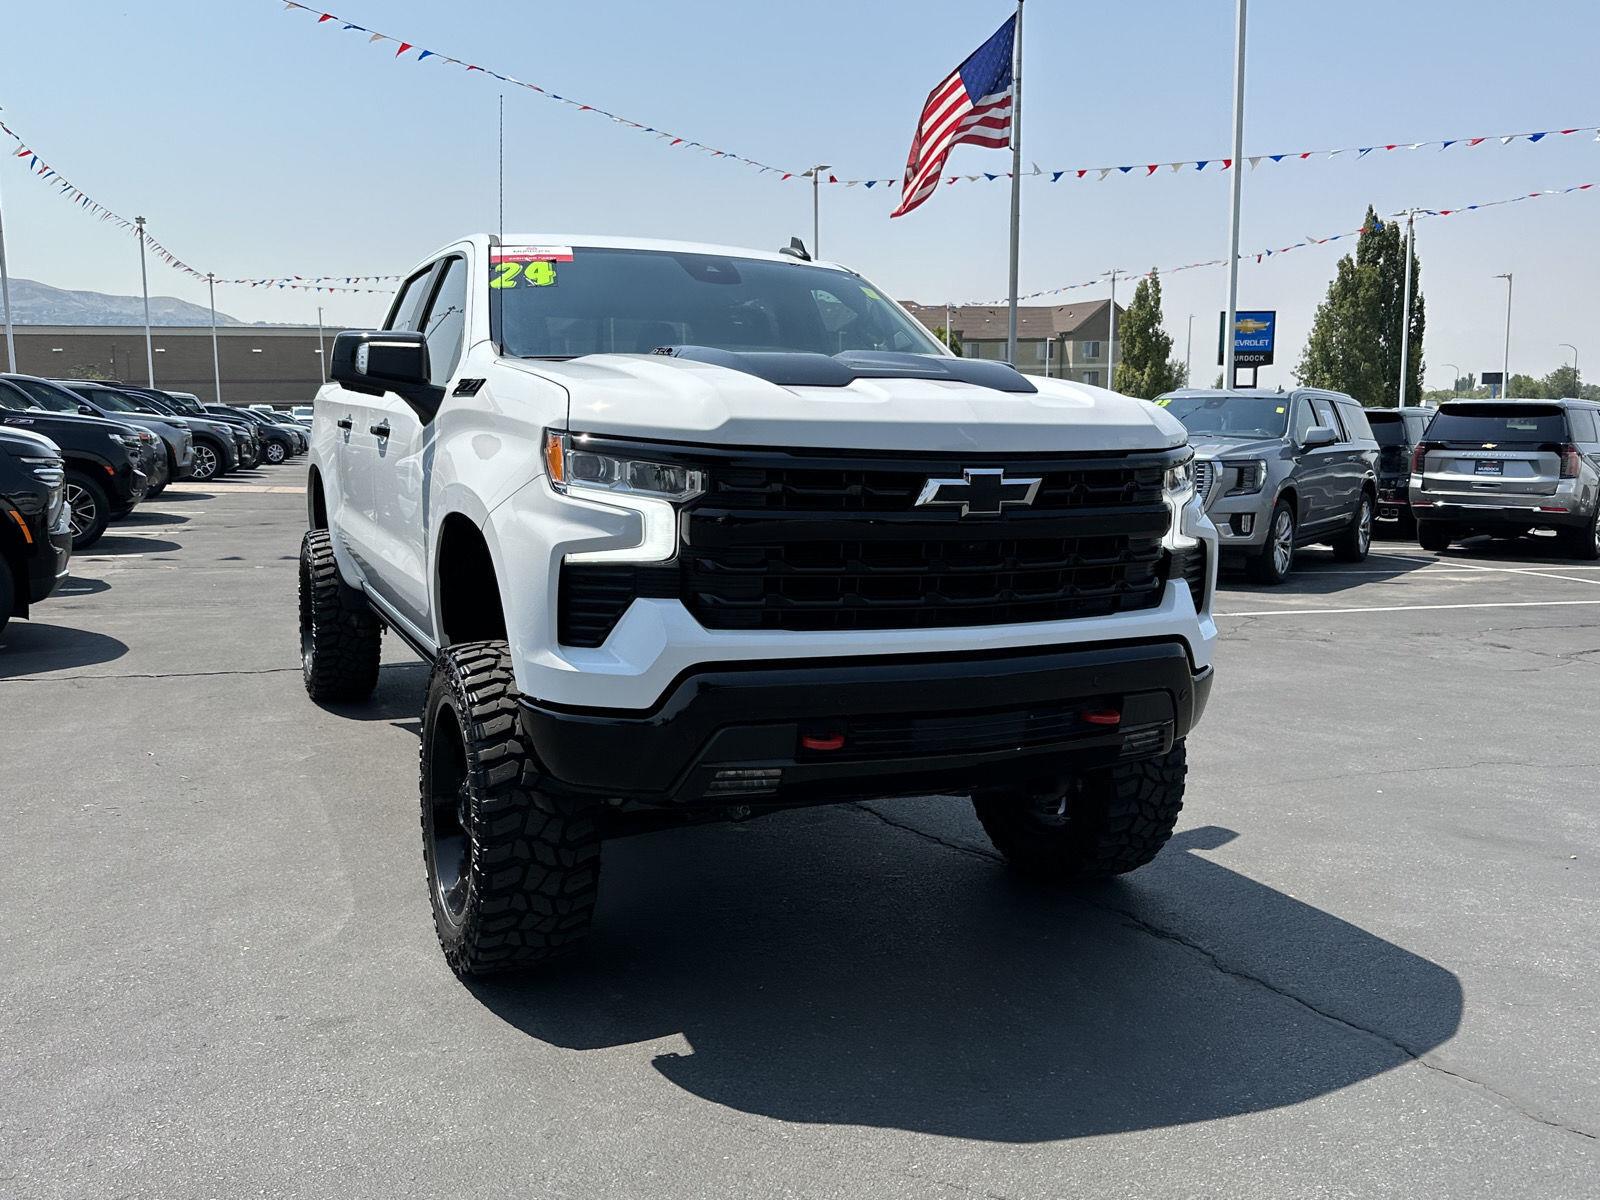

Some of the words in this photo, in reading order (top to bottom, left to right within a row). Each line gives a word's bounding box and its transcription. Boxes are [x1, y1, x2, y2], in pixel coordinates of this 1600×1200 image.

[489, 261, 556, 289] 24
[1234, 339, 1270, 347] EVROLET
[1234, 354, 1265, 362] URDOCK
